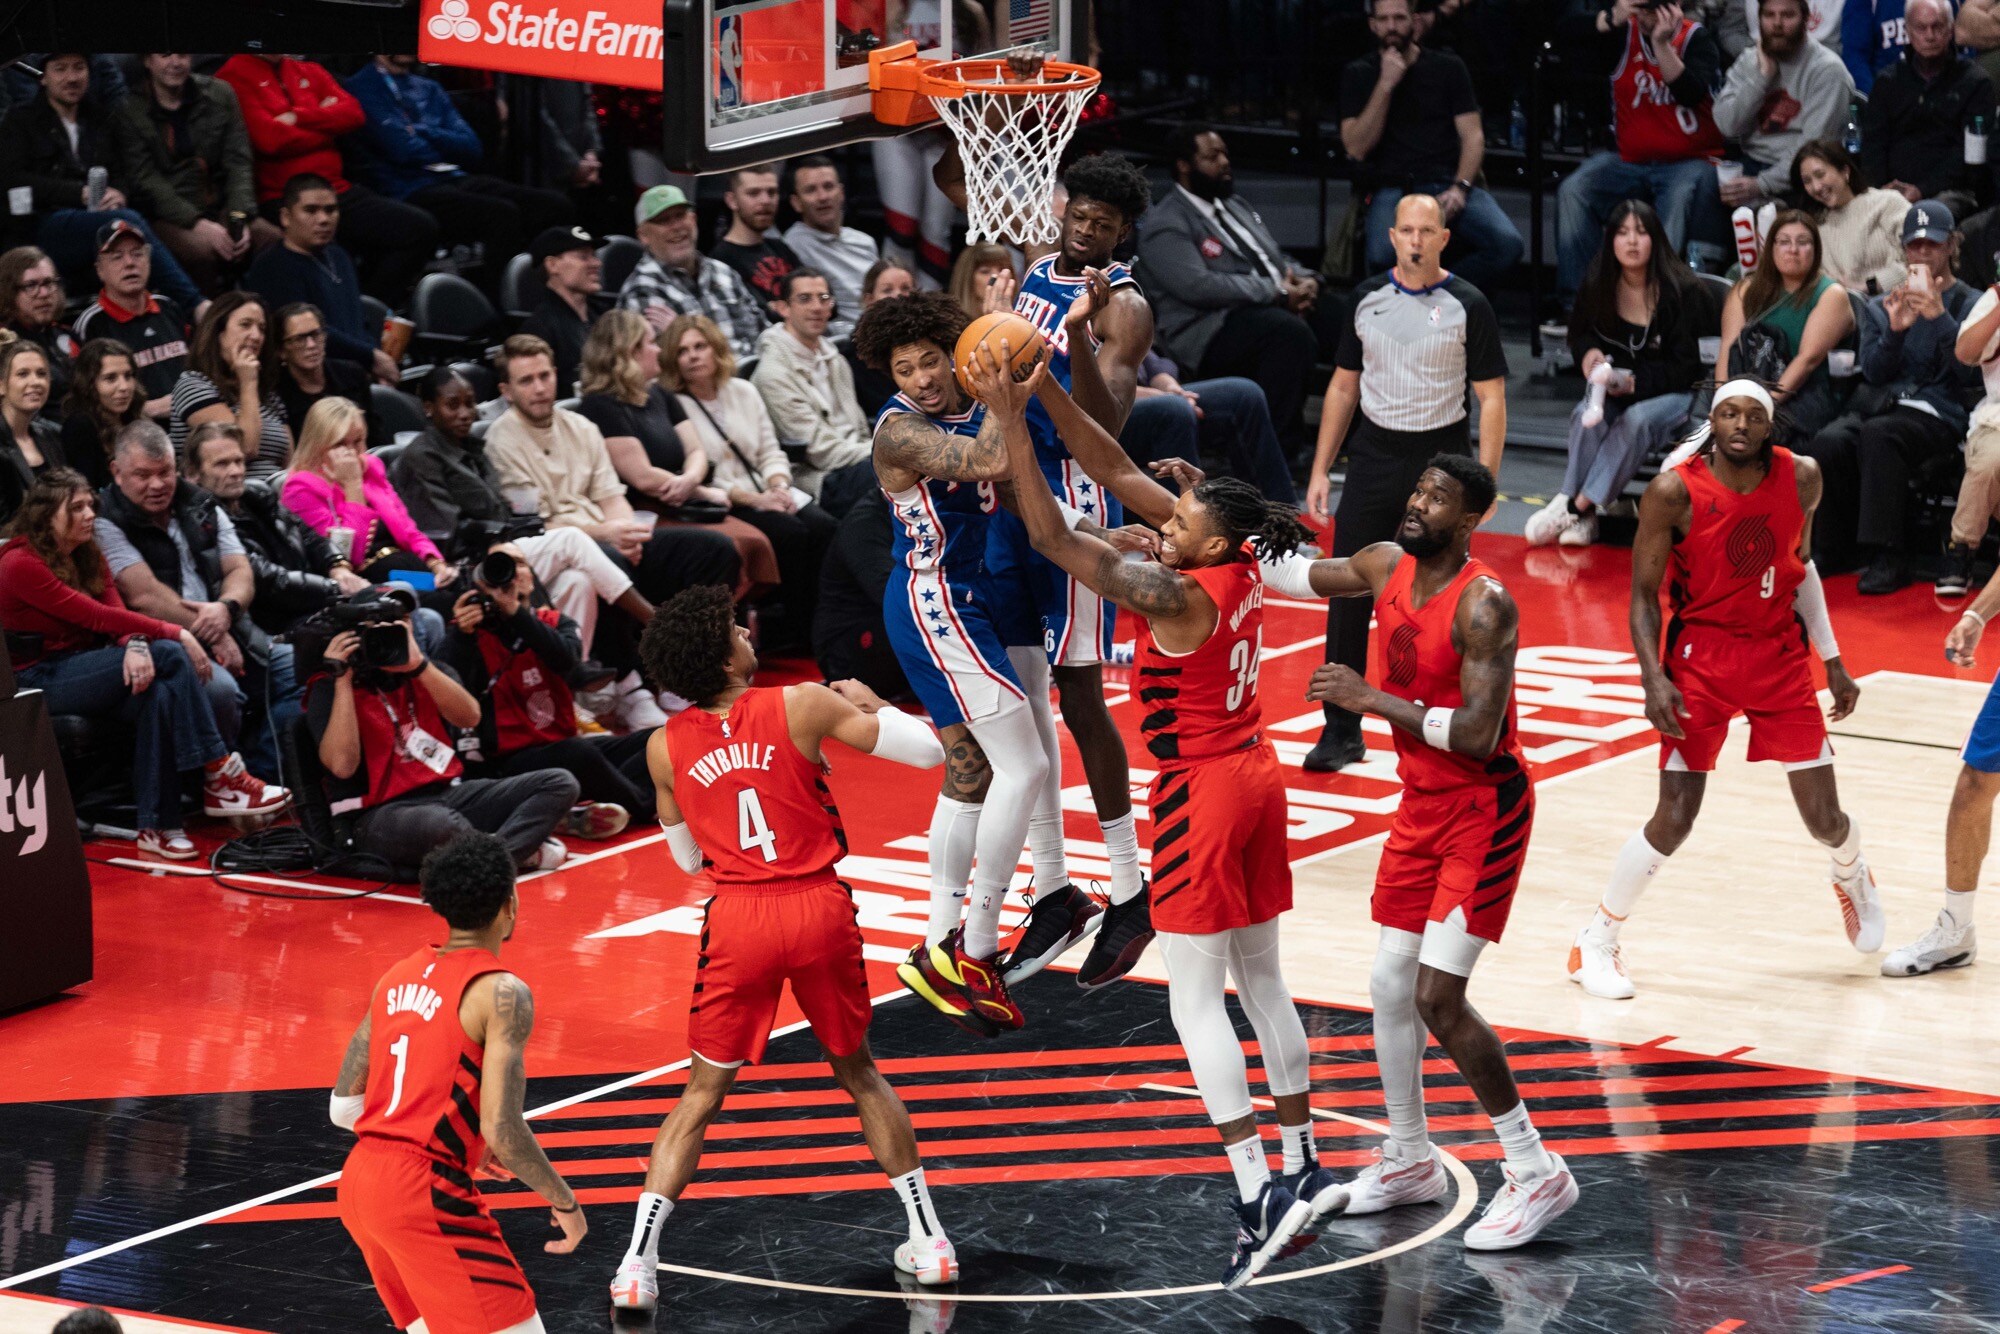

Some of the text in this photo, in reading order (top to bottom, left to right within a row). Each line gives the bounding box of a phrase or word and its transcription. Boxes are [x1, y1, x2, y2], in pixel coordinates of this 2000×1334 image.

[1011, 344, 1045, 383] ilson
[1760, 565, 1776, 599] 9
[1226, 623, 1262, 712] 34
[687, 742, 776, 789] THYBULLE
[737, 787, 778, 863] 4
[387, 983, 443, 1022] SIMONS
[384, 1034, 409, 1118] 1
